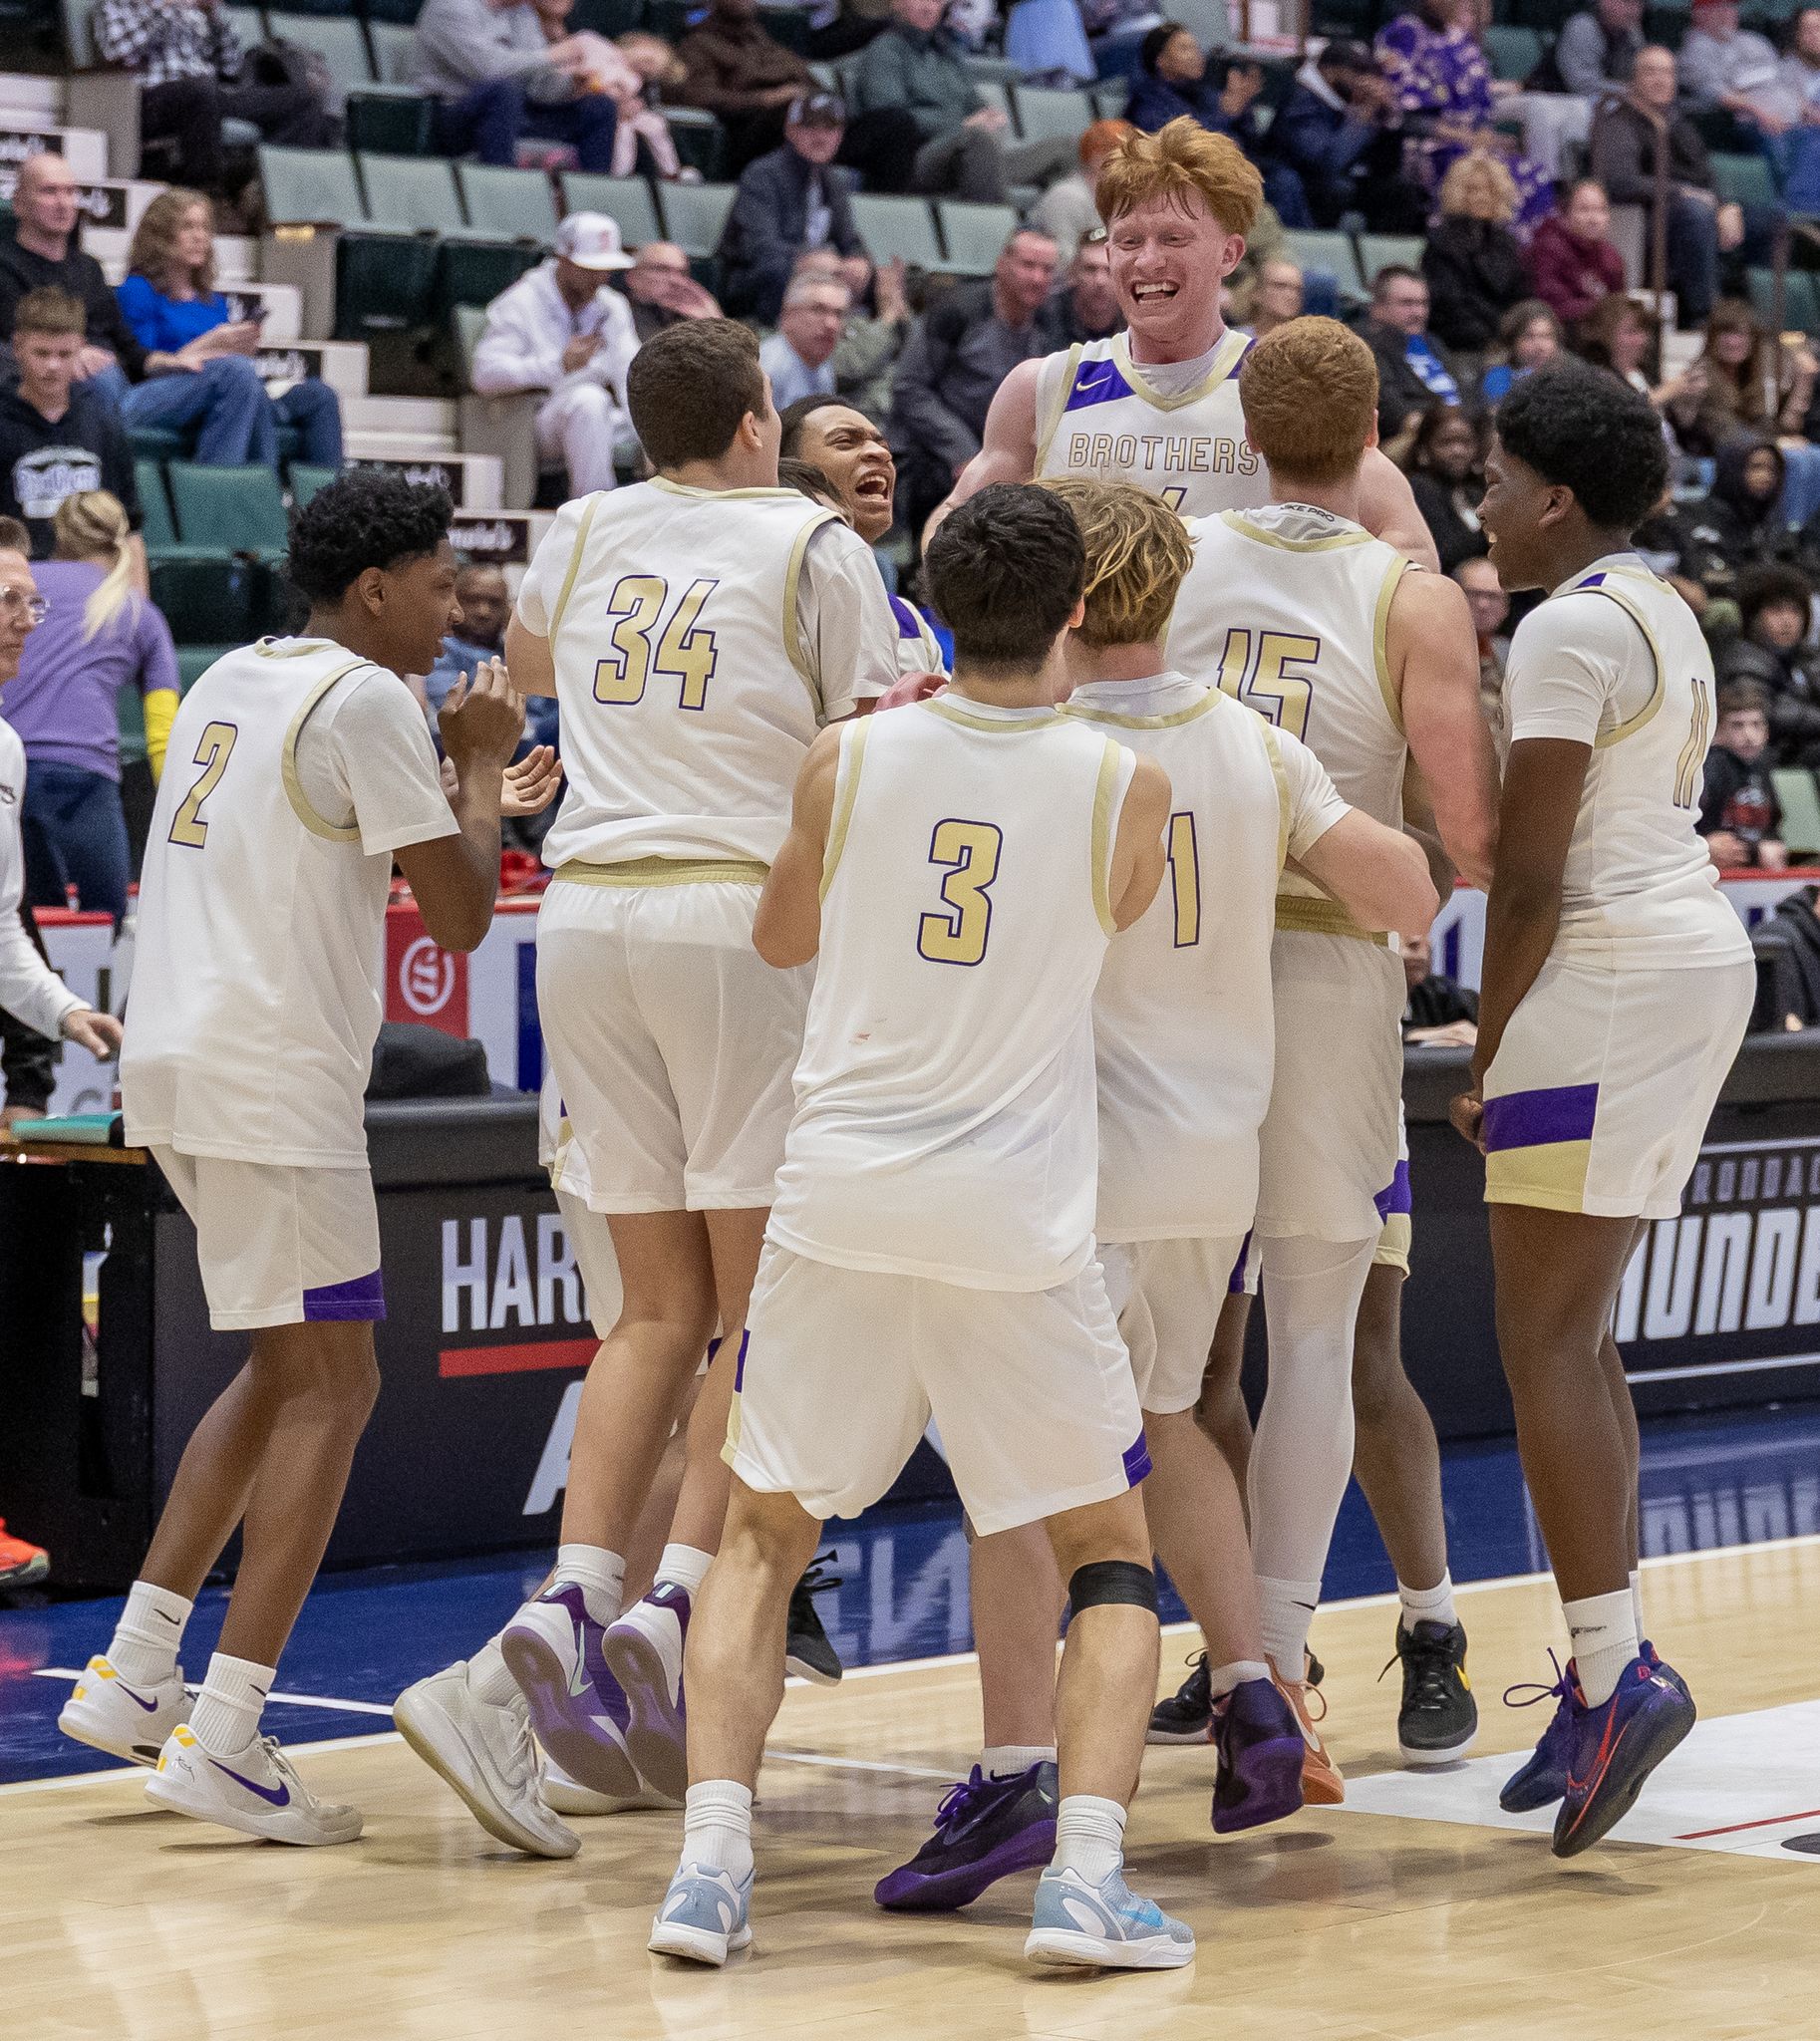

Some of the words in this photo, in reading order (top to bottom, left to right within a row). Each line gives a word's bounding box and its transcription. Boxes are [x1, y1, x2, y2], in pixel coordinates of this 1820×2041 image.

[1068, 433, 1258, 475] BROTHERS
[1307, 506, 1336, 522] PRO
[593, 574, 718, 712] 34
[1216, 628, 1321, 745] 15
[168, 721, 238, 849] 2
[1672, 678, 1709, 809] 11
[917, 818, 1003, 967] 3
[1167, 811, 1201, 949] 1
